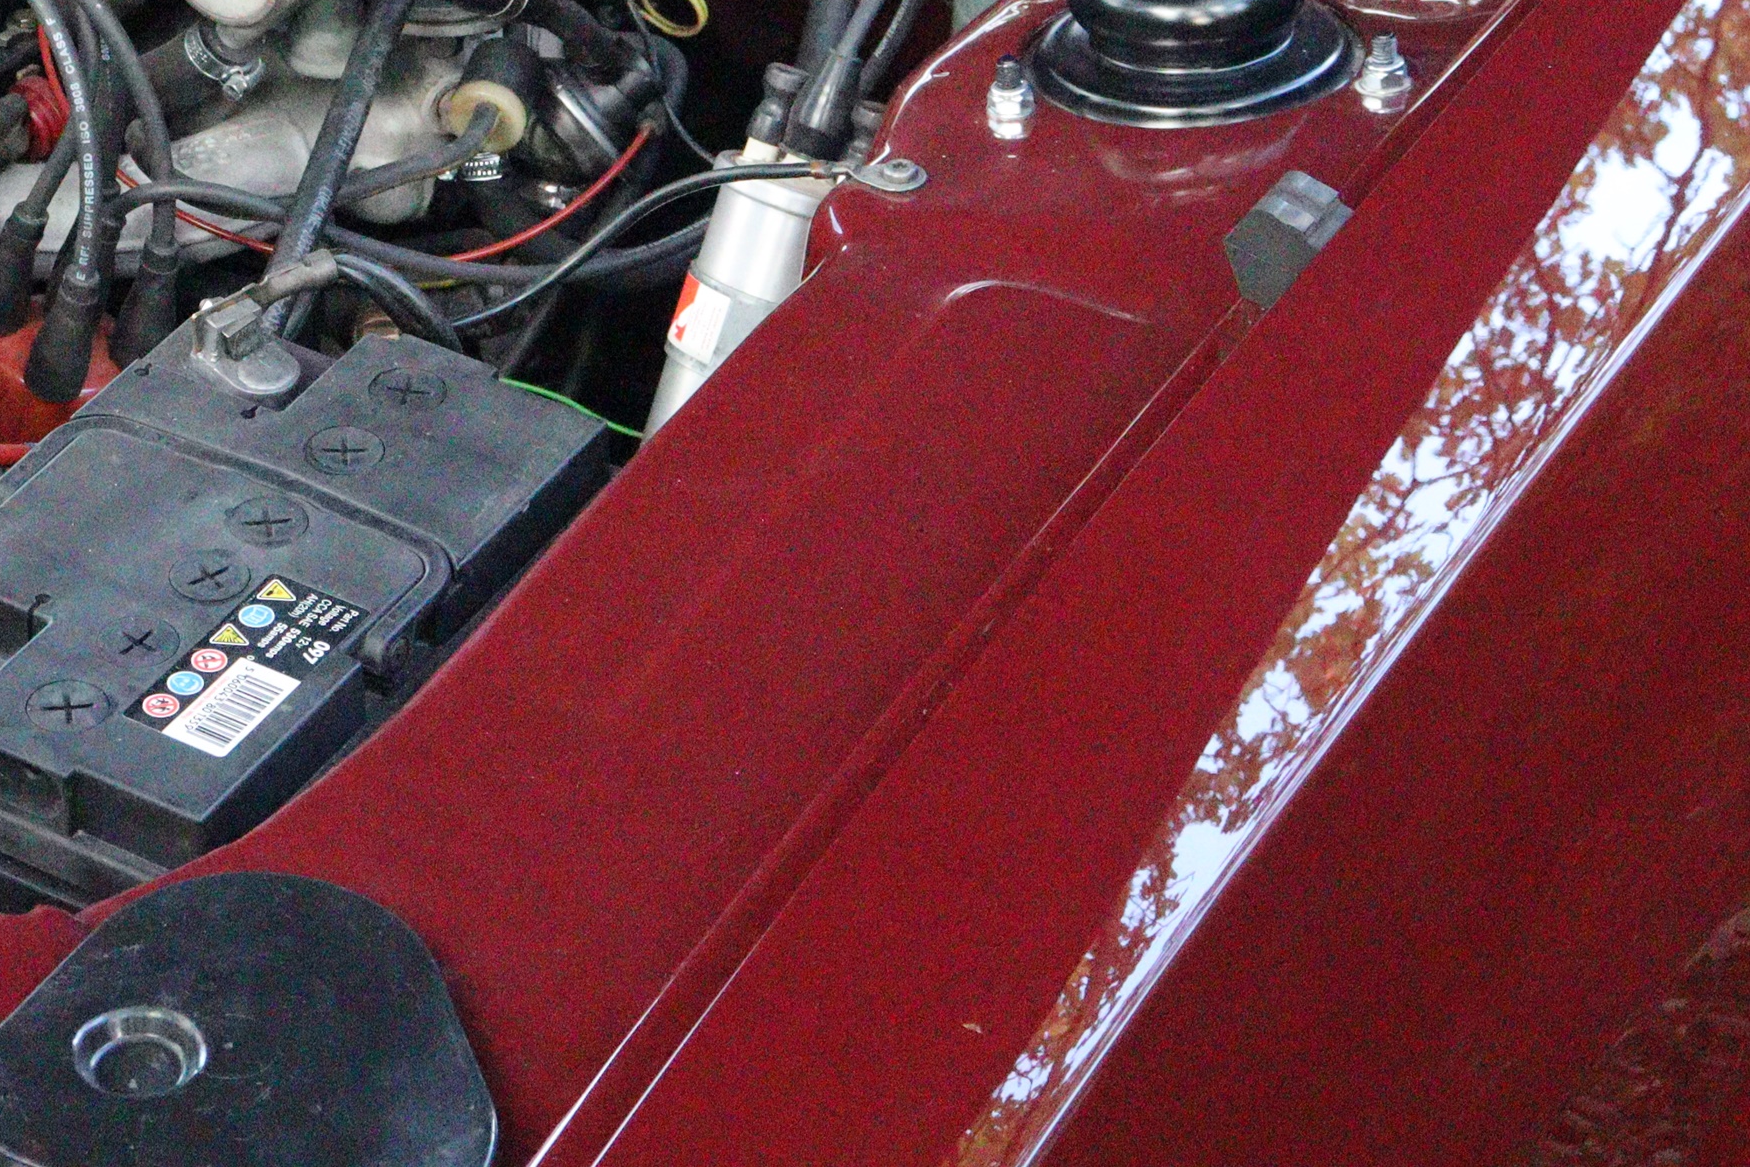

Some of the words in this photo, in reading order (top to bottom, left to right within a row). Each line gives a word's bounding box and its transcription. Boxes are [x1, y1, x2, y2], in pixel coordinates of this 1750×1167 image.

[45, 17, 57, 26] F
[52, 31, 76, 75] CLASS
[69, 82, 86, 112] 3808
[79, 121, 91, 144] ISO
[81, 152, 95, 238] SUPPRESSED
[312, 599, 332, 614] CCA
[318, 604, 346, 626] Voltage
[298, 612, 318, 628] SAE
[257, 622, 288, 648] 55amps
[265, 627, 301, 659] 530amps
[302, 641, 331, 665] 097
